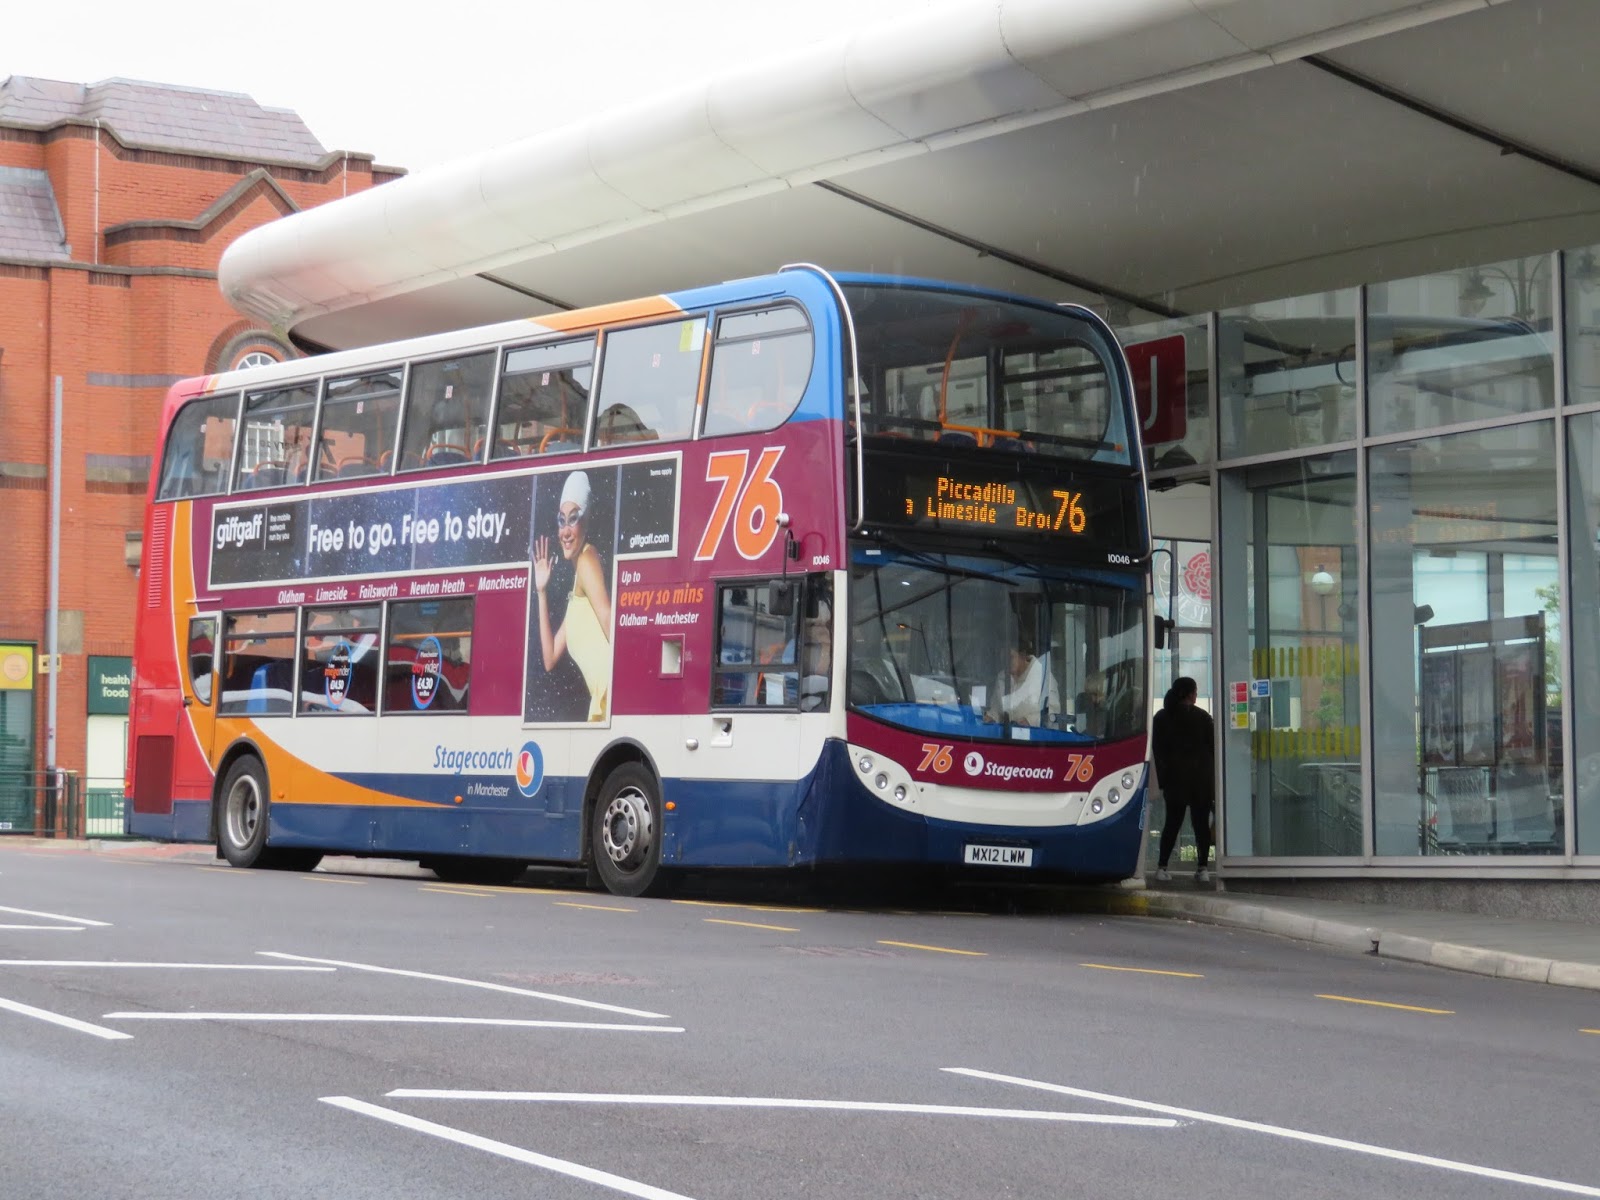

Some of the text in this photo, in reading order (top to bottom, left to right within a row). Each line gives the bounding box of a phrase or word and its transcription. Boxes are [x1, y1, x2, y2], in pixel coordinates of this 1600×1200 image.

[1144, 355, 1158, 430] J
[694, 445, 786, 561] 76
[937, 477, 1015, 504] Piccadilly
[927, 496, 997, 524] Limeside
[1053, 490, 1086, 533] 76
[216, 513, 263, 549] giffgaff
[309, 507, 510, 556] Free to go. Free to stay.
[630, 533, 670, 549] giffgaff.com
[812, 554, 830, 566] 10046
[1108, 553, 1131, 565] 10046
[277, 574, 527, 604] Oldham Limeside Failsworth Newton Heath Manchester
[621, 570, 641, 586] Up to
[620, 582, 704, 611] every 10 mins
[619, 611, 699, 627] Oldham Manchester
[101, 673, 130, 685] health
[102, 686, 129, 698] foods
[417, 677, 433, 690] £4.30
[433, 744, 513, 776] Stagecoach
[917, 743, 954, 773] 76
[984, 761, 1054, 781] Stagecoach
[1063, 754, 1095, 783] 76
[467, 782, 510, 797] in Manchester
[972, 847, 1026, 864] MX12 LWM
